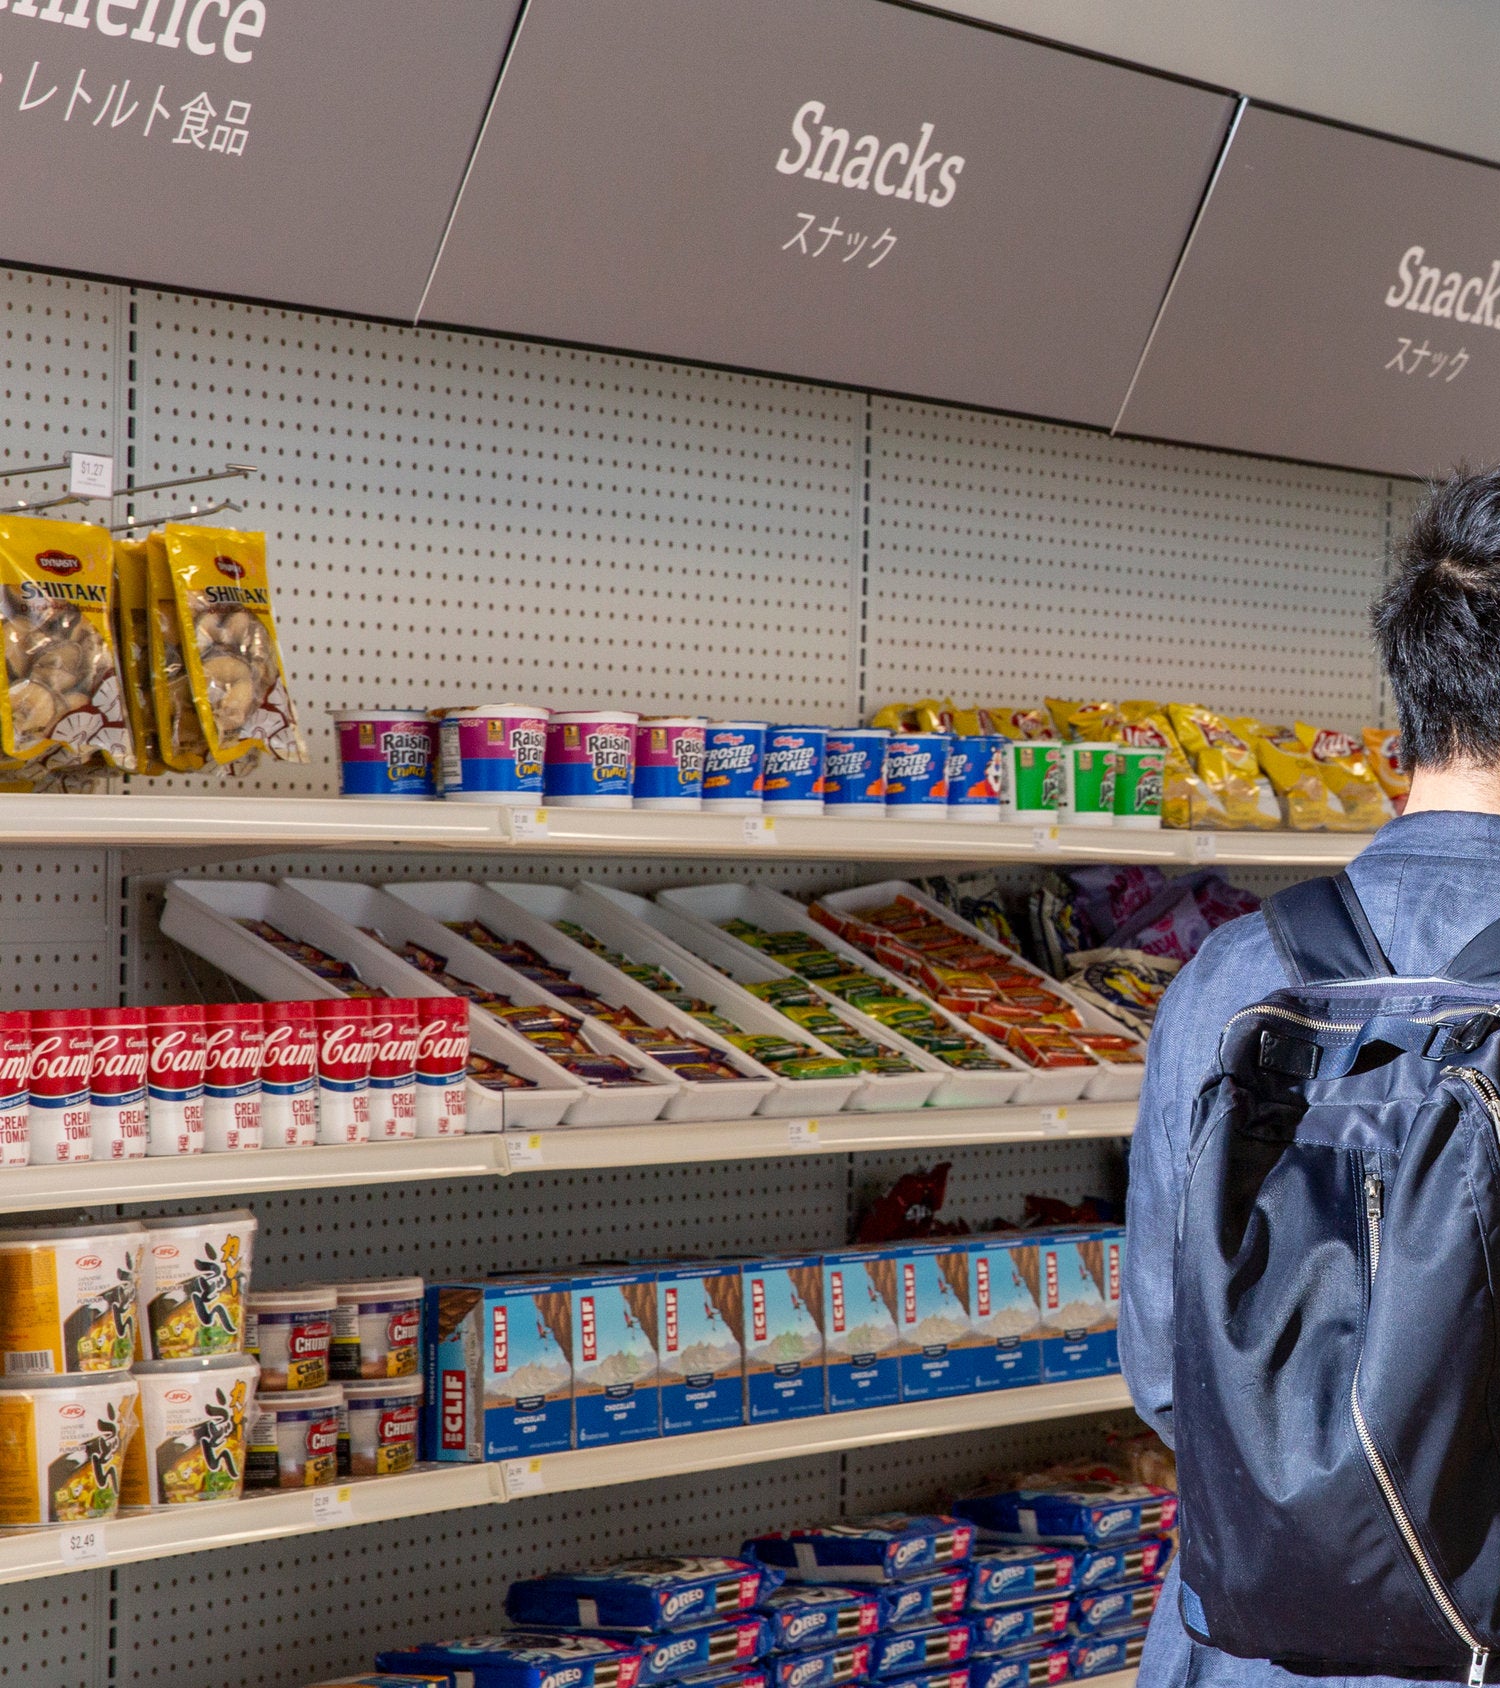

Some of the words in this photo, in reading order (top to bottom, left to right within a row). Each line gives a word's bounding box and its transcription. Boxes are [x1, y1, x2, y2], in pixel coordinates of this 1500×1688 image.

[776, 100, 966, 208] Snacks
[782, 212, 898, 268] スナック
[1385, 337, 1469, 383] スナック
[81, 460, 104, 477] $1.27
[383, 733, 431, 751] Raisin
[588, 735, 631, 752] Raisin
[390, 750, 426, 767] Bran
[595, 751, 627, 767] Bran
[705, 756, 751, 773] FLAKES
[765, 759, 811, 775] FLAKES
[905, 1268, 915, 1311] CLIF
[978, 1262, 989, 1303] CLIF
[1047, 1255, 1057, 1296] CLIF
[753, 1283, 765, 1328] CLIF
[832, 1276, 843, 1319] CLIF
[582, 1300, 596, 1348] CLIF
[666, 1292, 677, 1338] CLIF
[494, 1310, 507, 1358] CLIF
[445, 1375, 463, 1432] CLIF
[604, 1401, 636, 1412] CHOCOLATE
[513, 1413, 547, 1425] CHOCOLATE
[69, 1533, 95, 1549] $2.49
[895, 1539, 927, 1563] OREO
[664, 1588, 705, 1616] OREO
[789, 1612, 827, 1636] OREO
[653, 1638, 697, 1669] OREO
[791, 1658, 824, 1686] OREO
